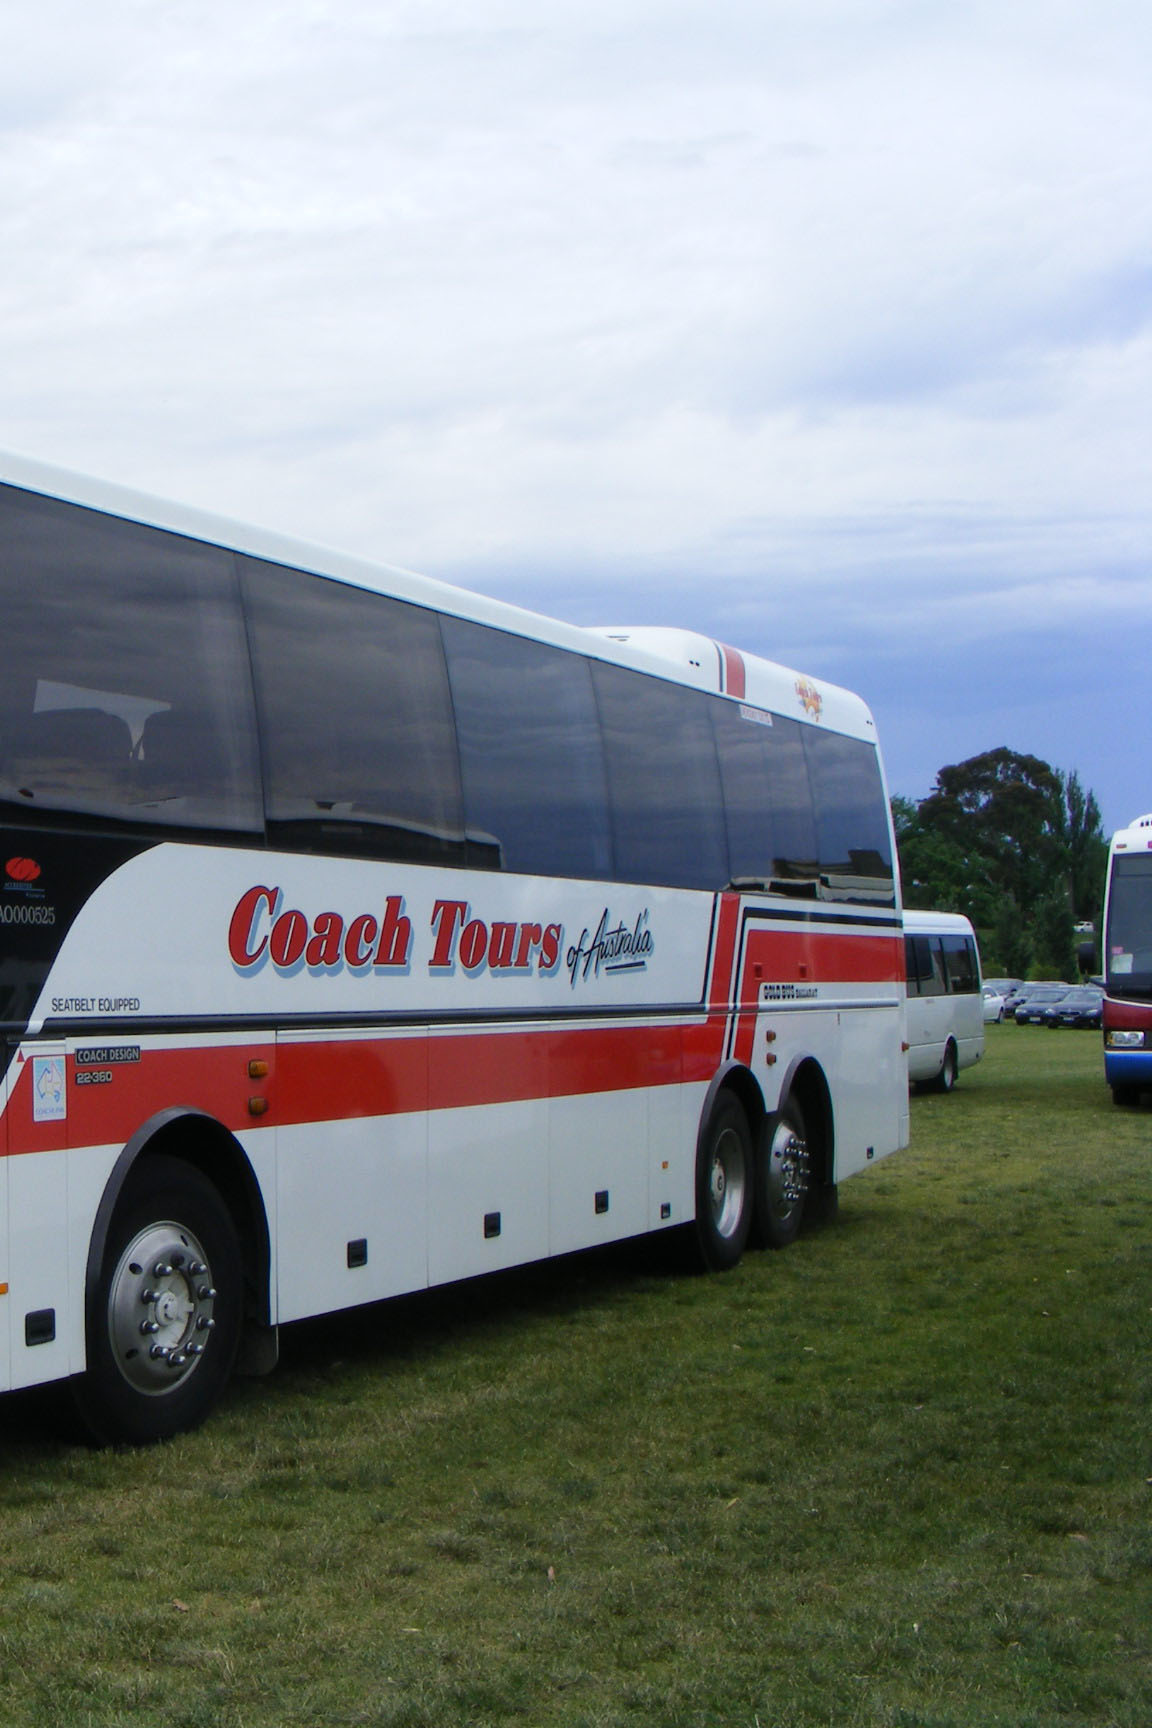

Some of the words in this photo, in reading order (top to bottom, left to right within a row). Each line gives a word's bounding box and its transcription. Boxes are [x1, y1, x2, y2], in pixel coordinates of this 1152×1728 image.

[228, 886, 415, 977] Coach
[428, 900, 564, 978] Tours
[567, 928, 589, 990] of
[583, 907, 654, 983] Australia
[51, 998, 96, 1012] SEATBELT
[98, 998, 141, 1012] EQUIPPED
[77, 1049, 108, 1063] COACH
[109, 1046, 140, 1061] DESIGN
